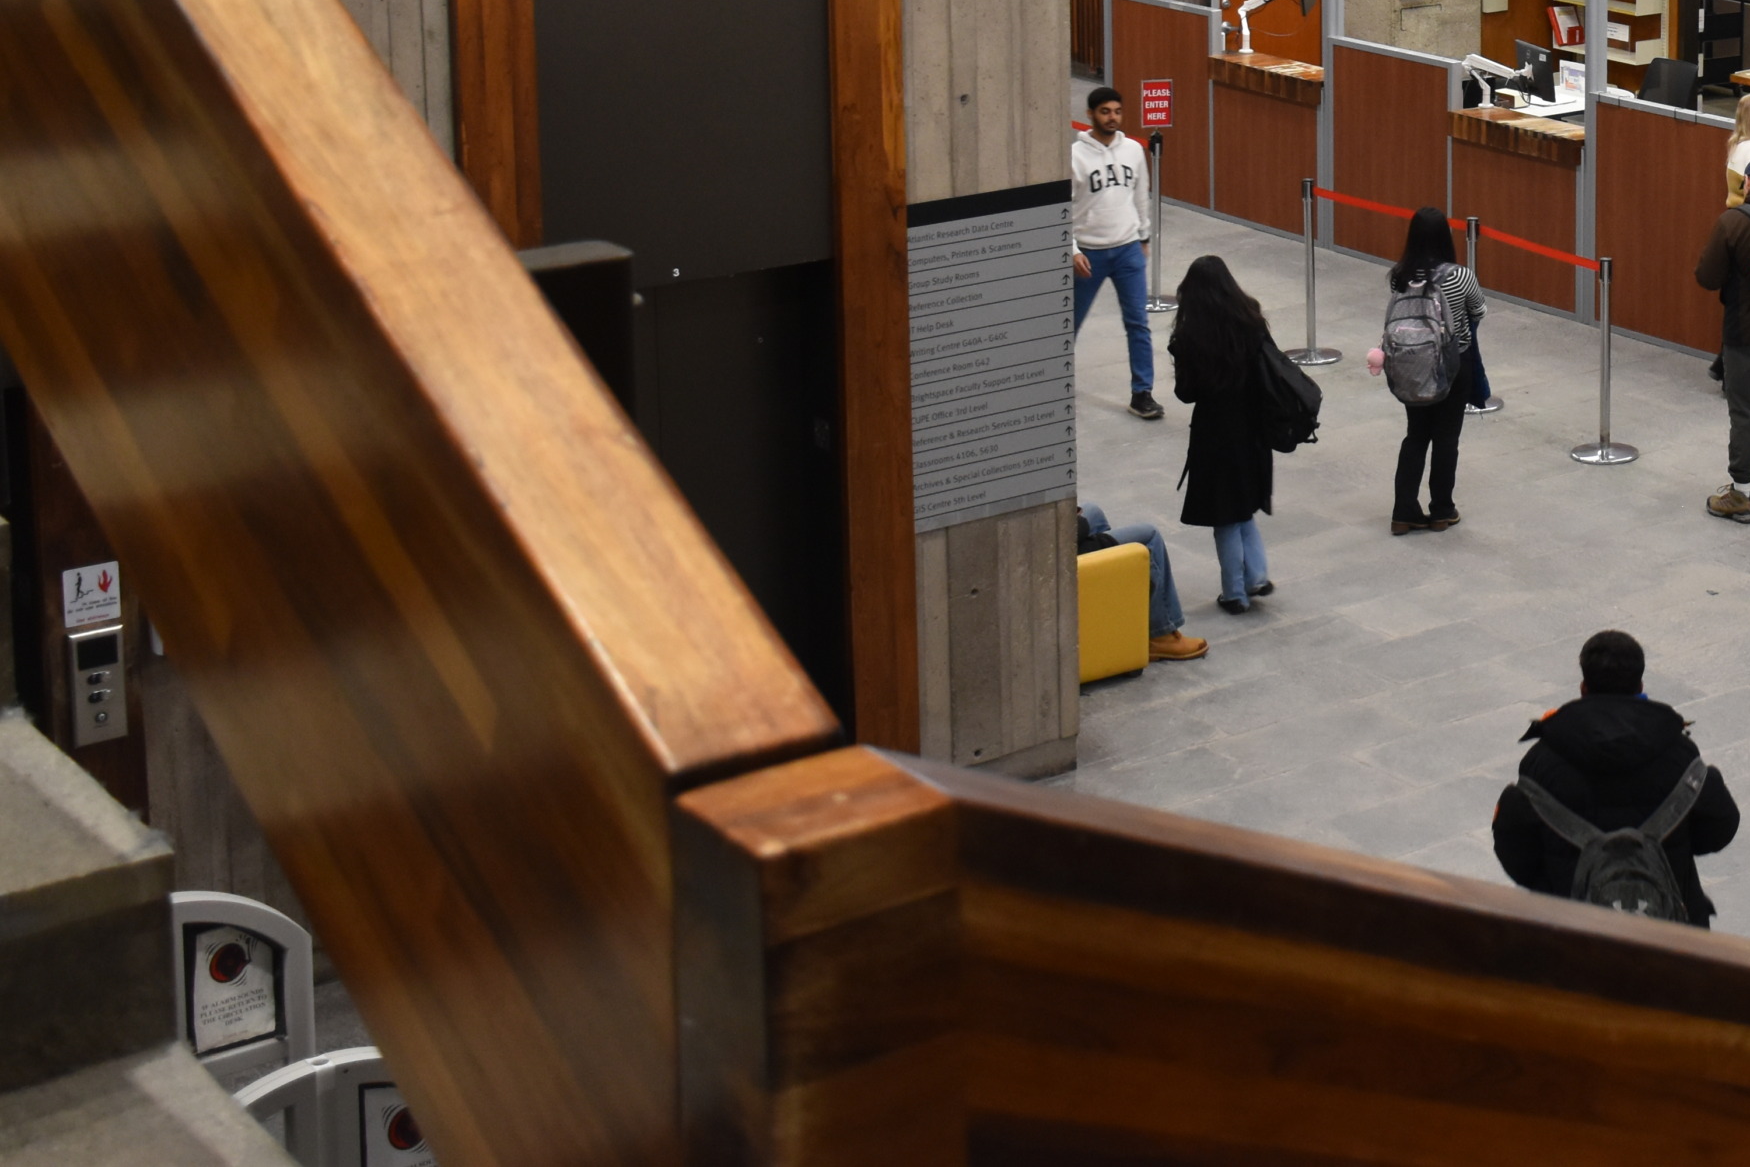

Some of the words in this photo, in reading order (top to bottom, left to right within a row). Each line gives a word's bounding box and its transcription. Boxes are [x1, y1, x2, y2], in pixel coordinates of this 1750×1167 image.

[1143, 89, 1171, 97] PLEASE
[1145, 101, 1168, 109] ENTER
[1147, 112, 1166, 120] HERE
[1089, 164, 1133, 193] GAP
[936, 227, 970, 238] Research
[972, 223, 989, 234] Data
[990, 220, 1014, 230] Centre
[951, 248, 979, 259] Printers
[989, 241, 1021, 253] Scanners
[932, 274, 953, 286] Study
[955, 271, 980, 281] Rooms
[946, 293, 983, 305] Collection
[917, 321, 934, 333] Help
[936, 319, 954, 329] Desk
[937, 342, 961, 353] Centre
[952, 362, 974, 372] Room
[955, 384, 981, 396] Faculty
[982, 377, 1011, 389] Support
[1013, 372, 1025, 382] 3rd
[1027, 369, 1045, 379] Level
[932, 411, 953, 421] Office
[956, 405, 967, 416] 3rd
[969, 402, 988, 413] Level
[957, 425, 990, 437] Research
[992, 419, 1021, 430] Services
[1023, 413, 1035, 423] 3rd
[1037, 410, 1055, 421] Level
[953, 472, 980, 484] Special
[982, 462, 1021, 476] Collections
[1023, 457, 1035, 468] 5th
[1036, 454, 1055, 465] Level
[927, 500, 950, 512] Centre
[953, 494, 966, 505] 5th
[967, 491, 986, 502] Level
